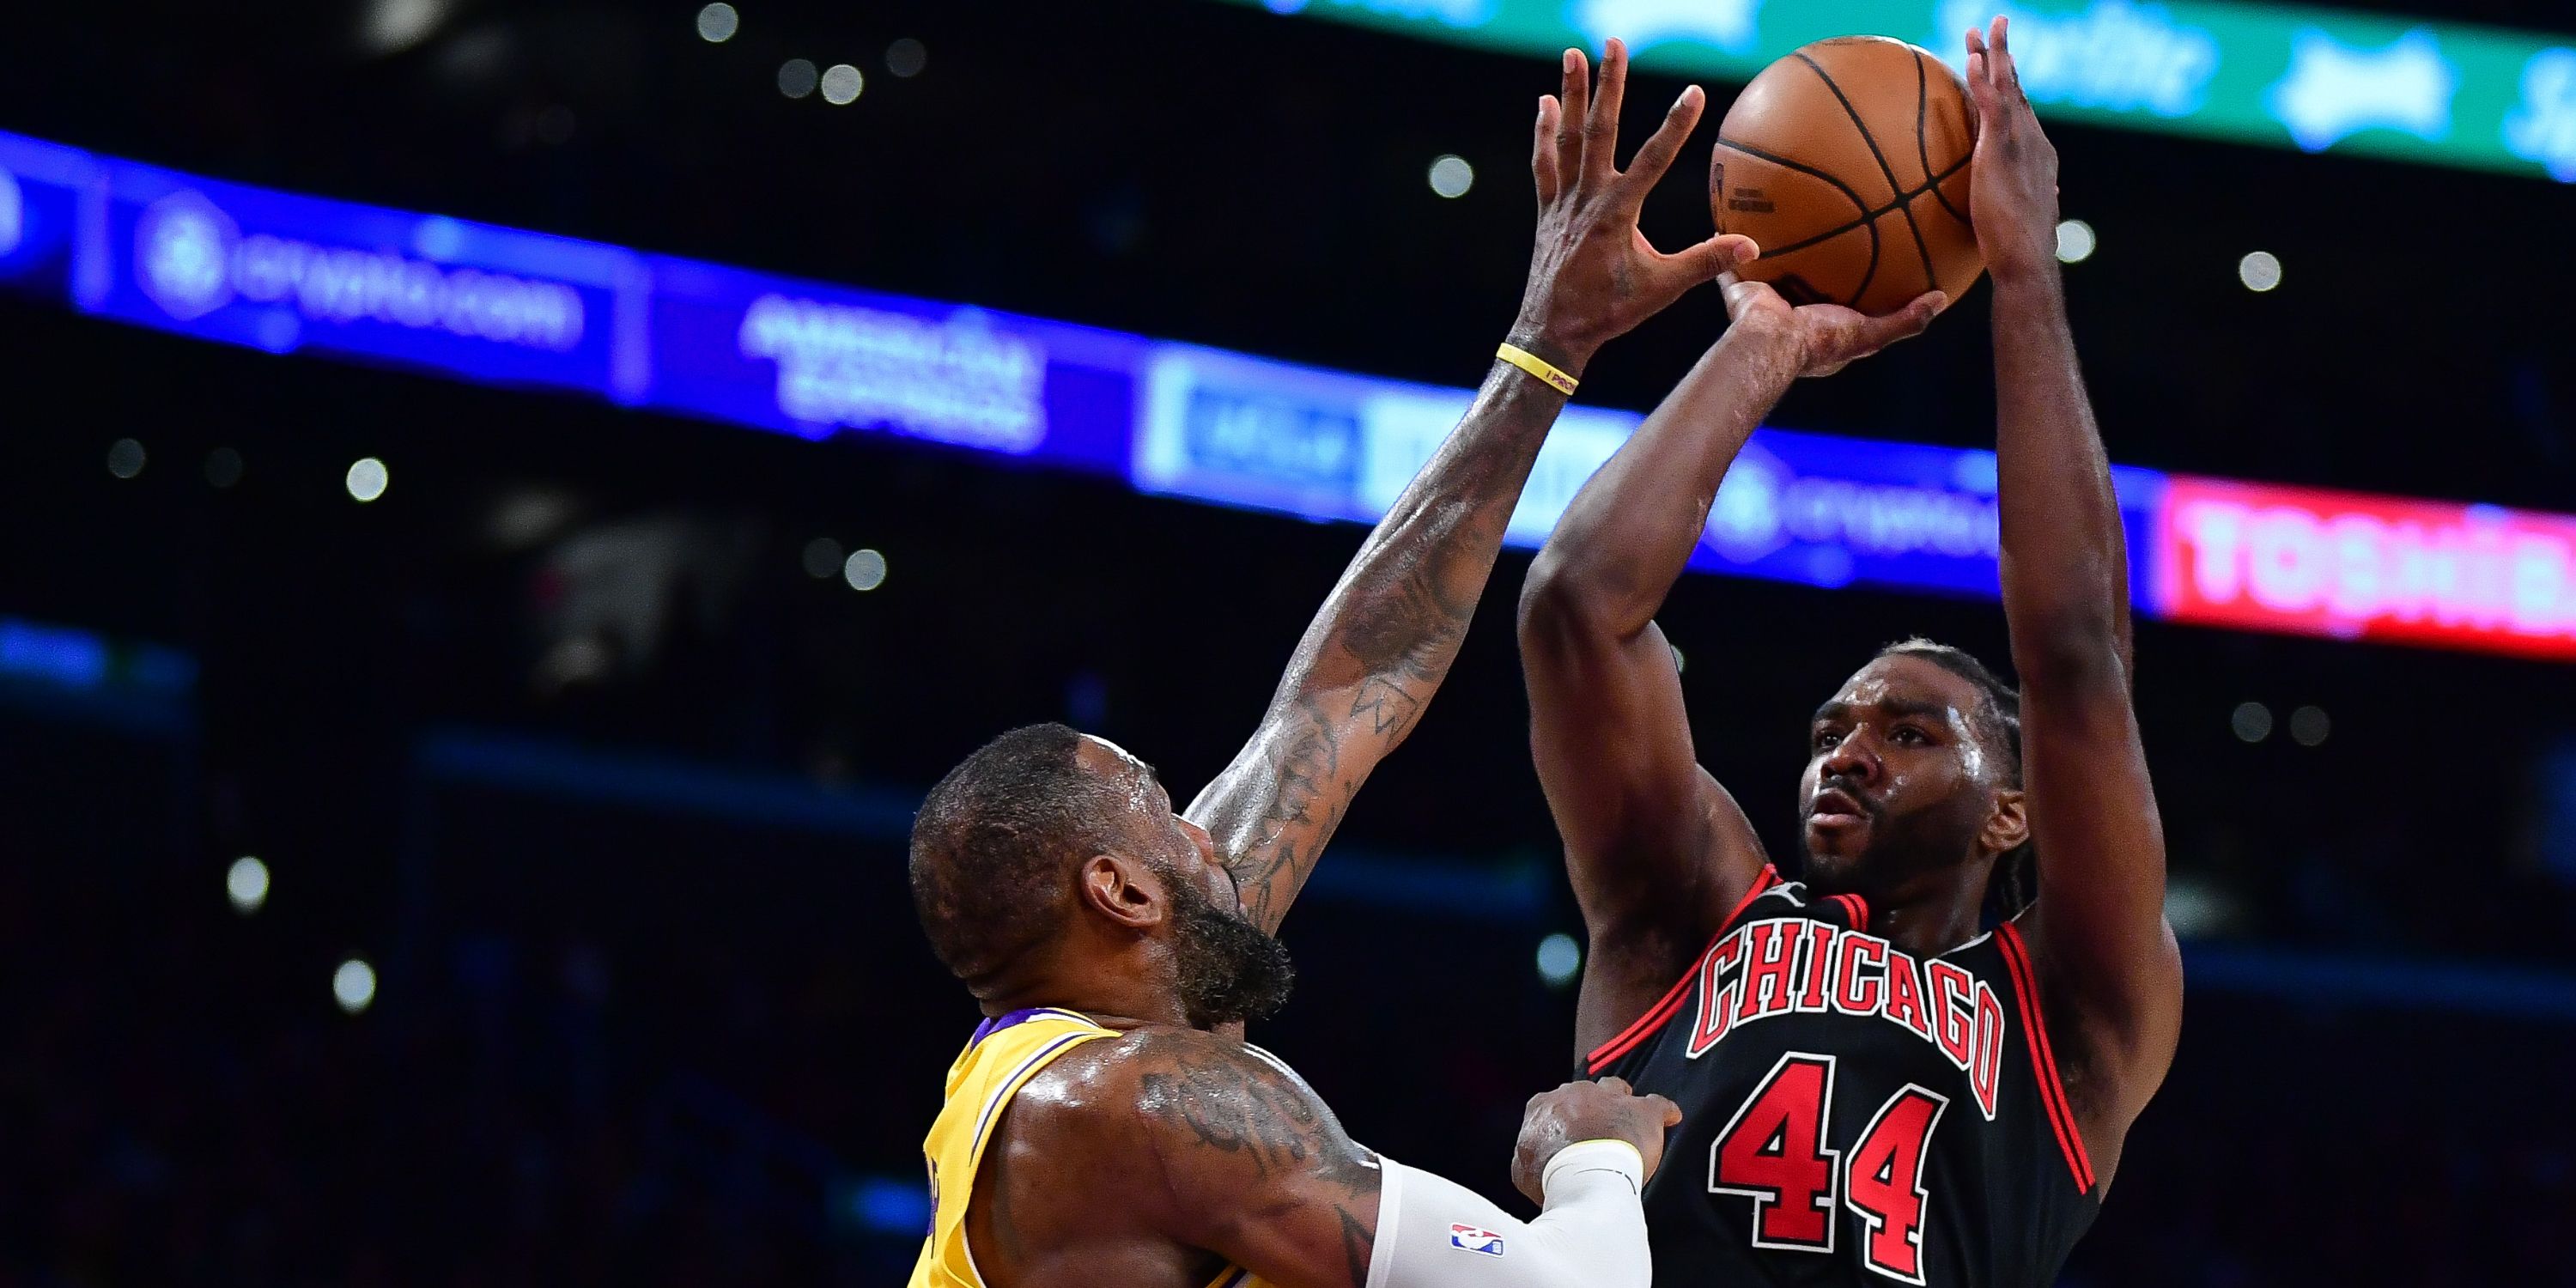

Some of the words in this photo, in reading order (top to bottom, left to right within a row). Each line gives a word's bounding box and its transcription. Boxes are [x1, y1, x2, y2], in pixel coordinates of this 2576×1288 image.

[2176, 500, 2576, 639] TOSHIB
[1686, 917, 2005, 1121] CHICAGO
[1707, 1050, 1950, 1287] 44
